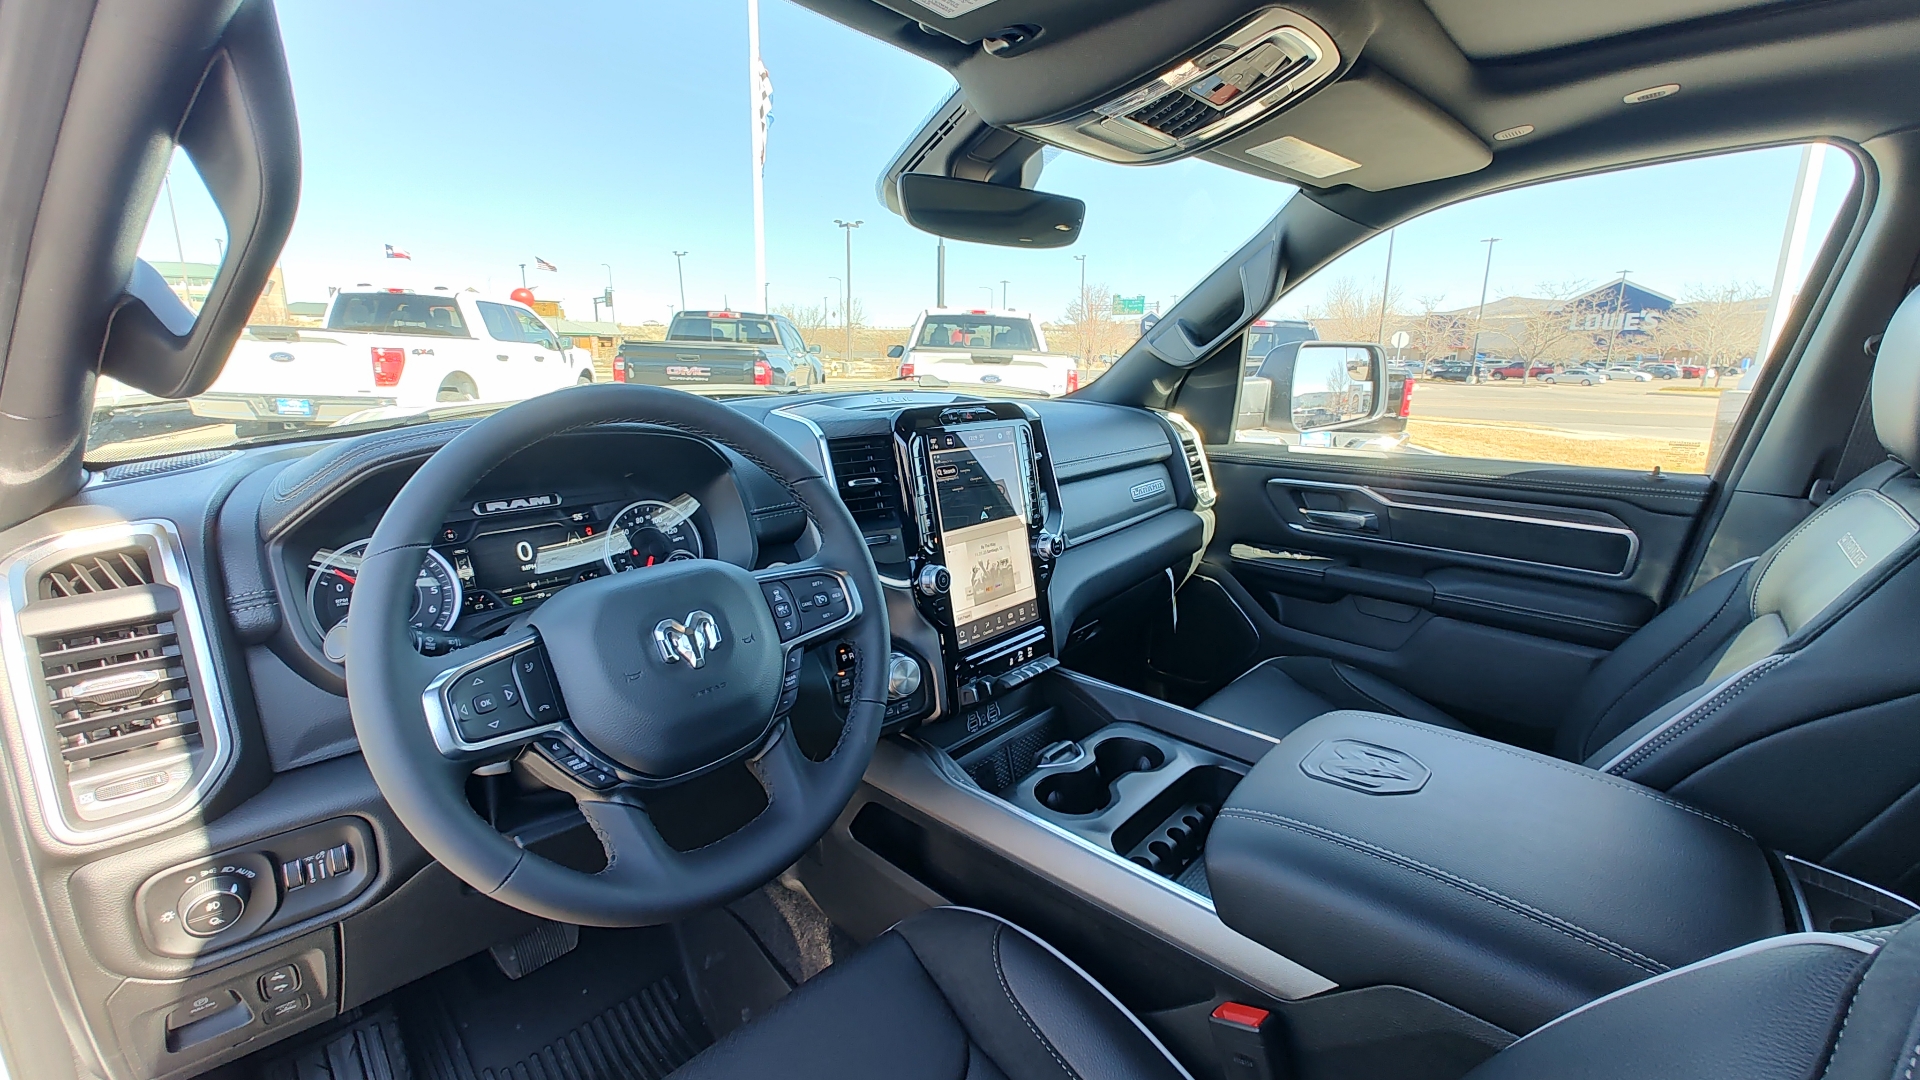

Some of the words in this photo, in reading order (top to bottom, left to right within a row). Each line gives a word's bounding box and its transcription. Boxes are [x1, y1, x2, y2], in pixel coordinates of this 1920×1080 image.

[1569, 310, 1659, 331] LOWE'S
[666, 366, 711, 376] GMC
[485, 495, 551, 511] RAM
[635, 516, 644, 524] 80
[667, 527, 678, 535] 120
[516, 541, 533, 561] 0
[521, 563, 537, 572] MPH
[419, 569, 427, 577] 4
[335, 583, 344, 592] 0
[430, 586, 438, 595] 5
[428, 605, 437, 613] 6
[480, 698, 492, 707] OK
[235, 867, 256, 879] AUTO
